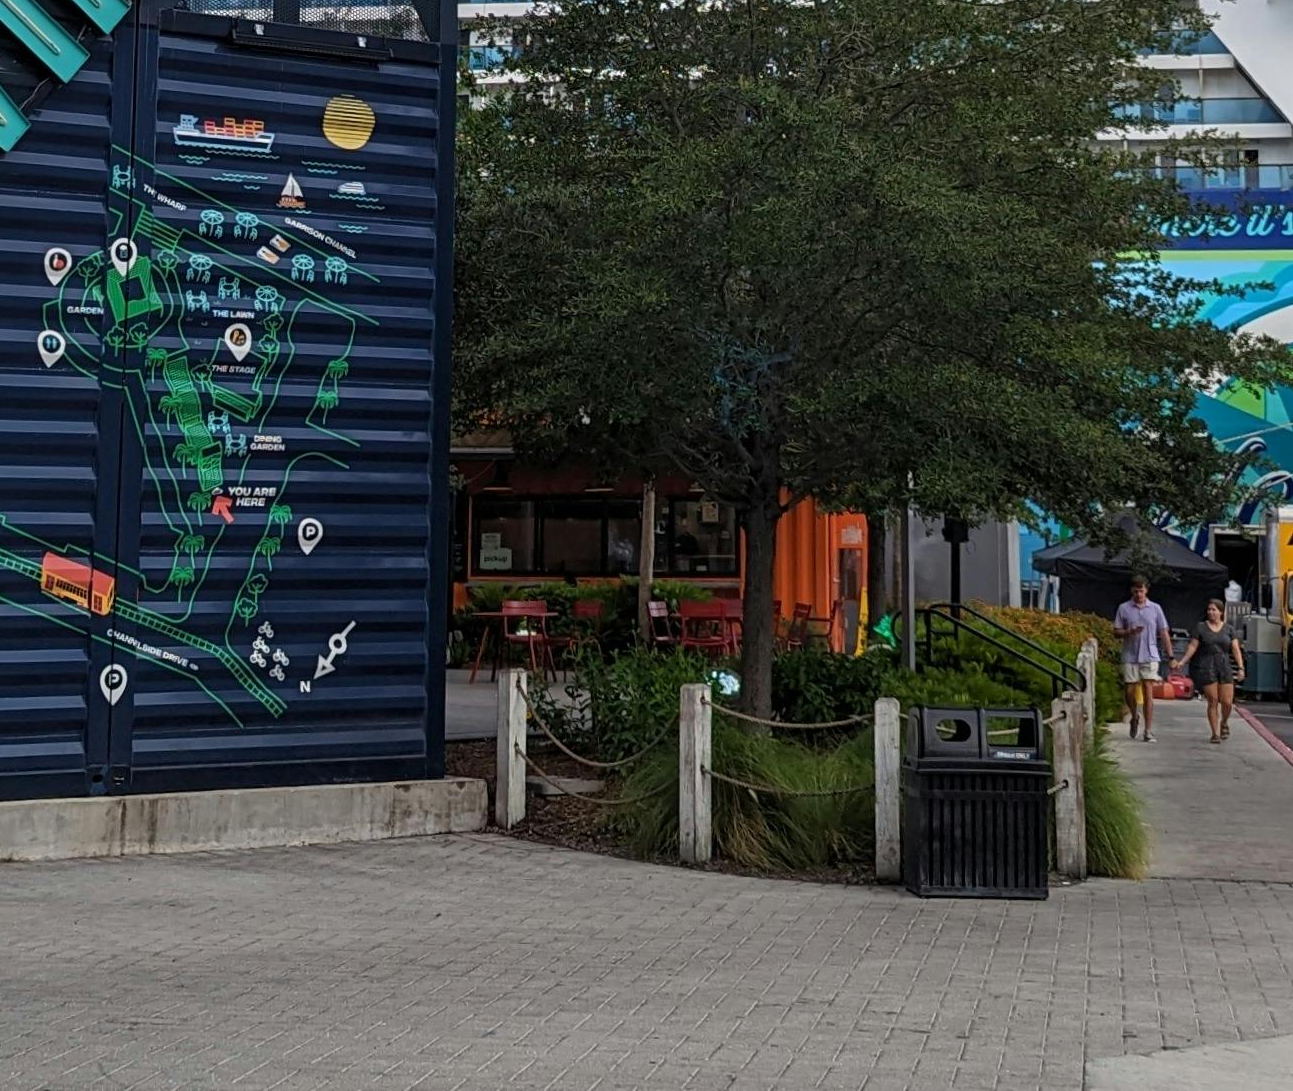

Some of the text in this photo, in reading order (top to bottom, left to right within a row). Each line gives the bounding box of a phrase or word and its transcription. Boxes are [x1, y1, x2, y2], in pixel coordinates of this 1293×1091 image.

[143, 183, 187, 212] TH WHARF
[284, 217, 357, 259] GARRISON CHANNEL
[67, 306, 104, 315] GARDEN
[212, 309, 255, 319] THE LAWN
[211, 364, 256, 374] THE STAGE
[250, 442, 285, 451] GARDEN
[228, 487, 277, 497] YOU ARE
[235, 497, 266, 506] HERE
[107, 628, 189, 667] CHANNLSIDE DRIVE
[300, 681, 311, 692] N
